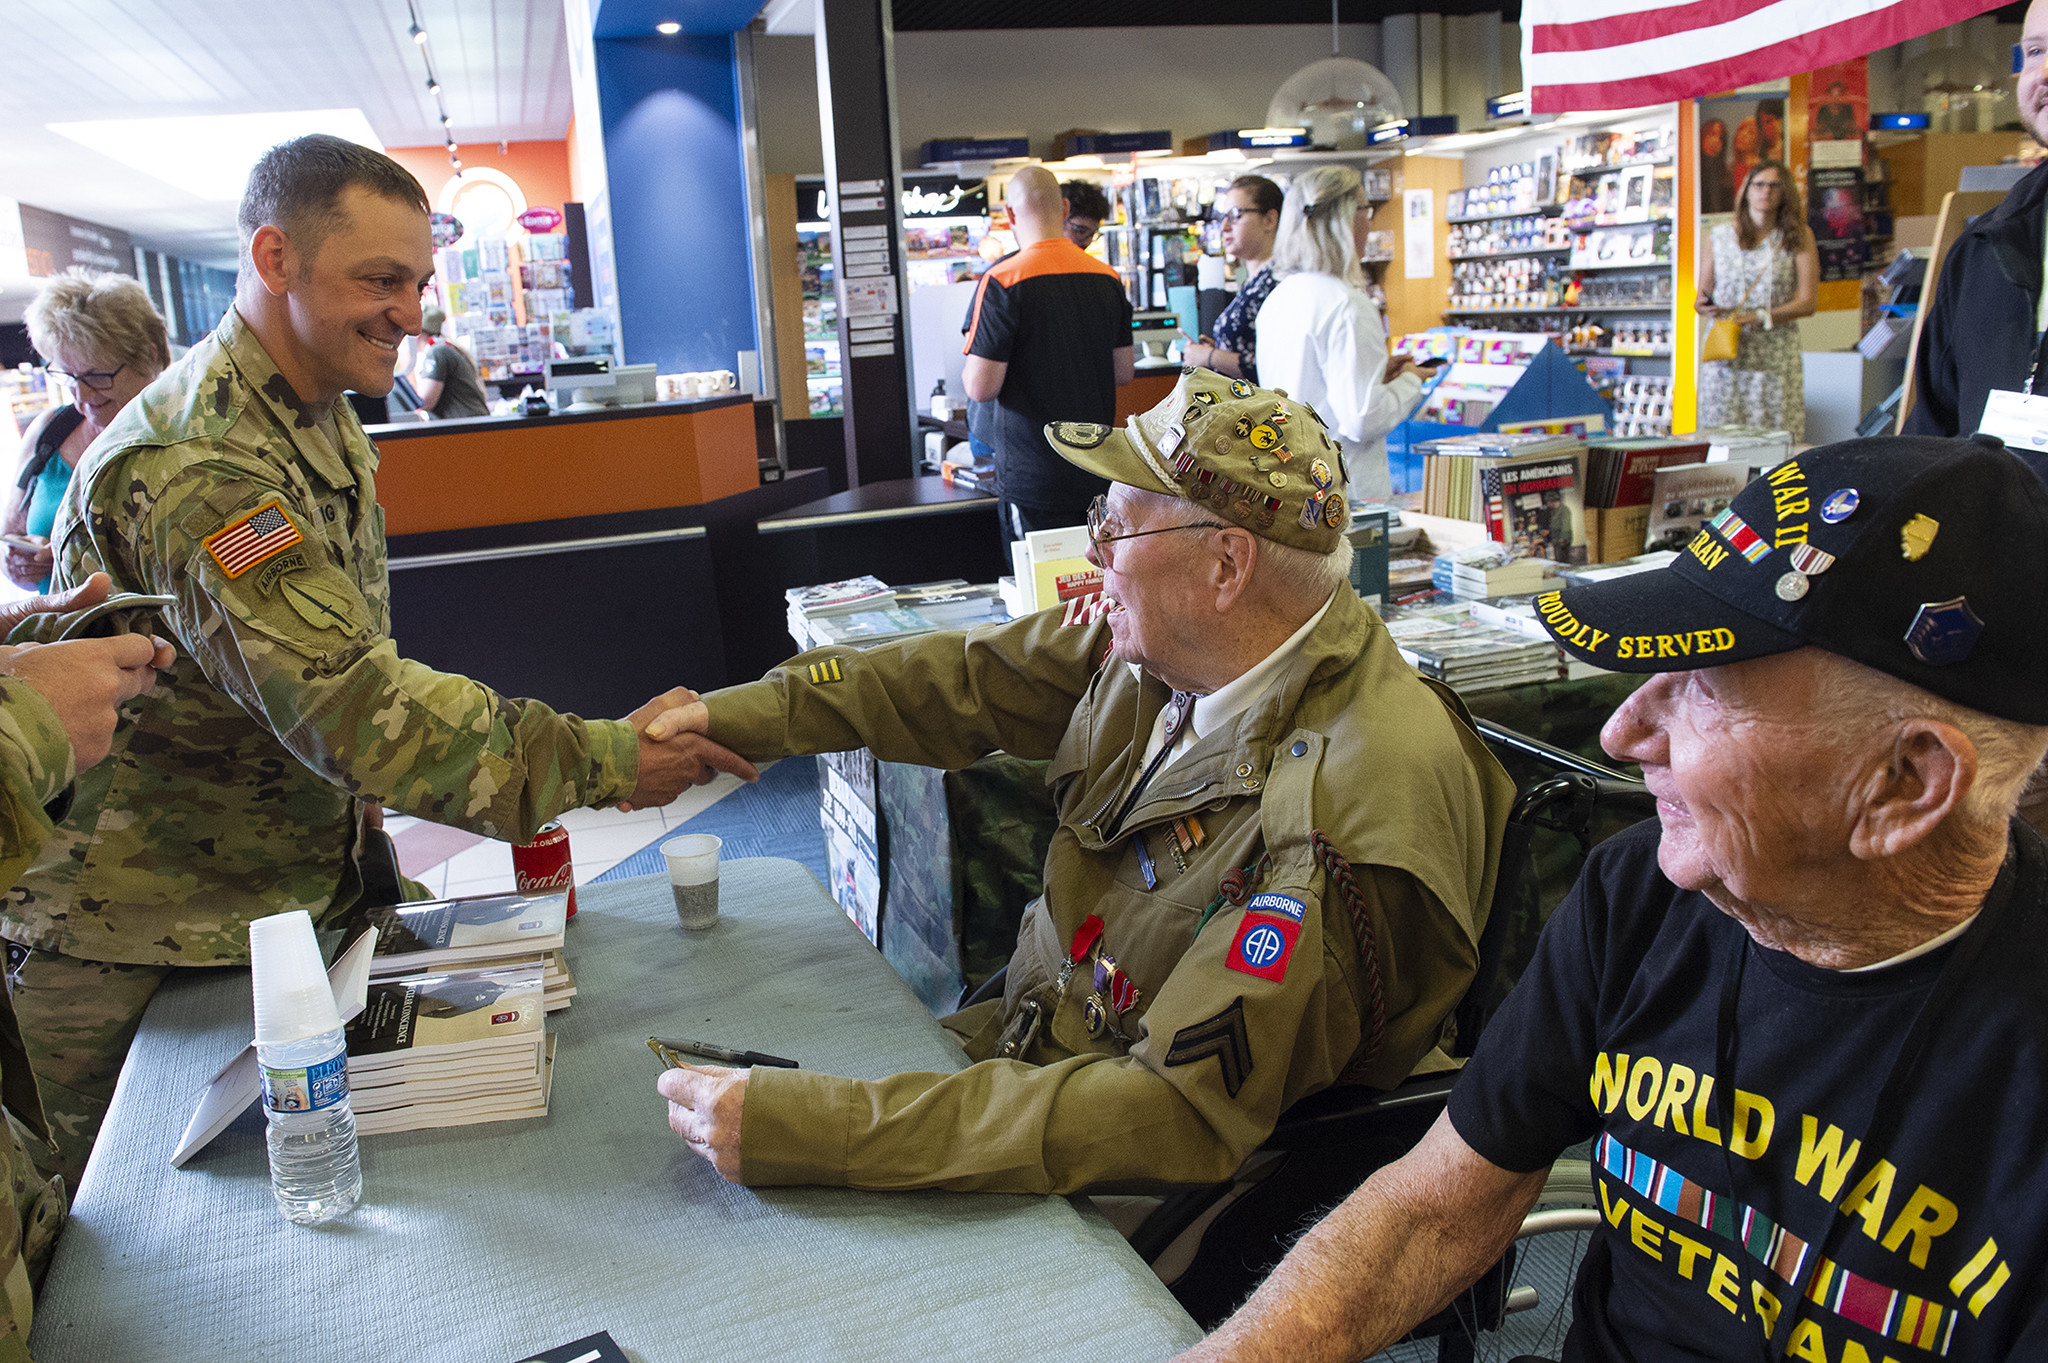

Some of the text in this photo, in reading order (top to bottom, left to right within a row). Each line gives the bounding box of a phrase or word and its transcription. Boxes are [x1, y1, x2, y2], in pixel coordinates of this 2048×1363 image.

[1502, 470, 1519, 484] LES
[1767, 461, 1810, 549] WAR II
[260, 556, 304, 590] AIRBORNE
[1617, 627, 1736, 659] SERVED
[1250, 895, 1304, 918] AIRBORNE
[396, 1005, 412, 1045] CONSCIENCE
[1590, 1051, 2012, 1320] WORLD WAR II
